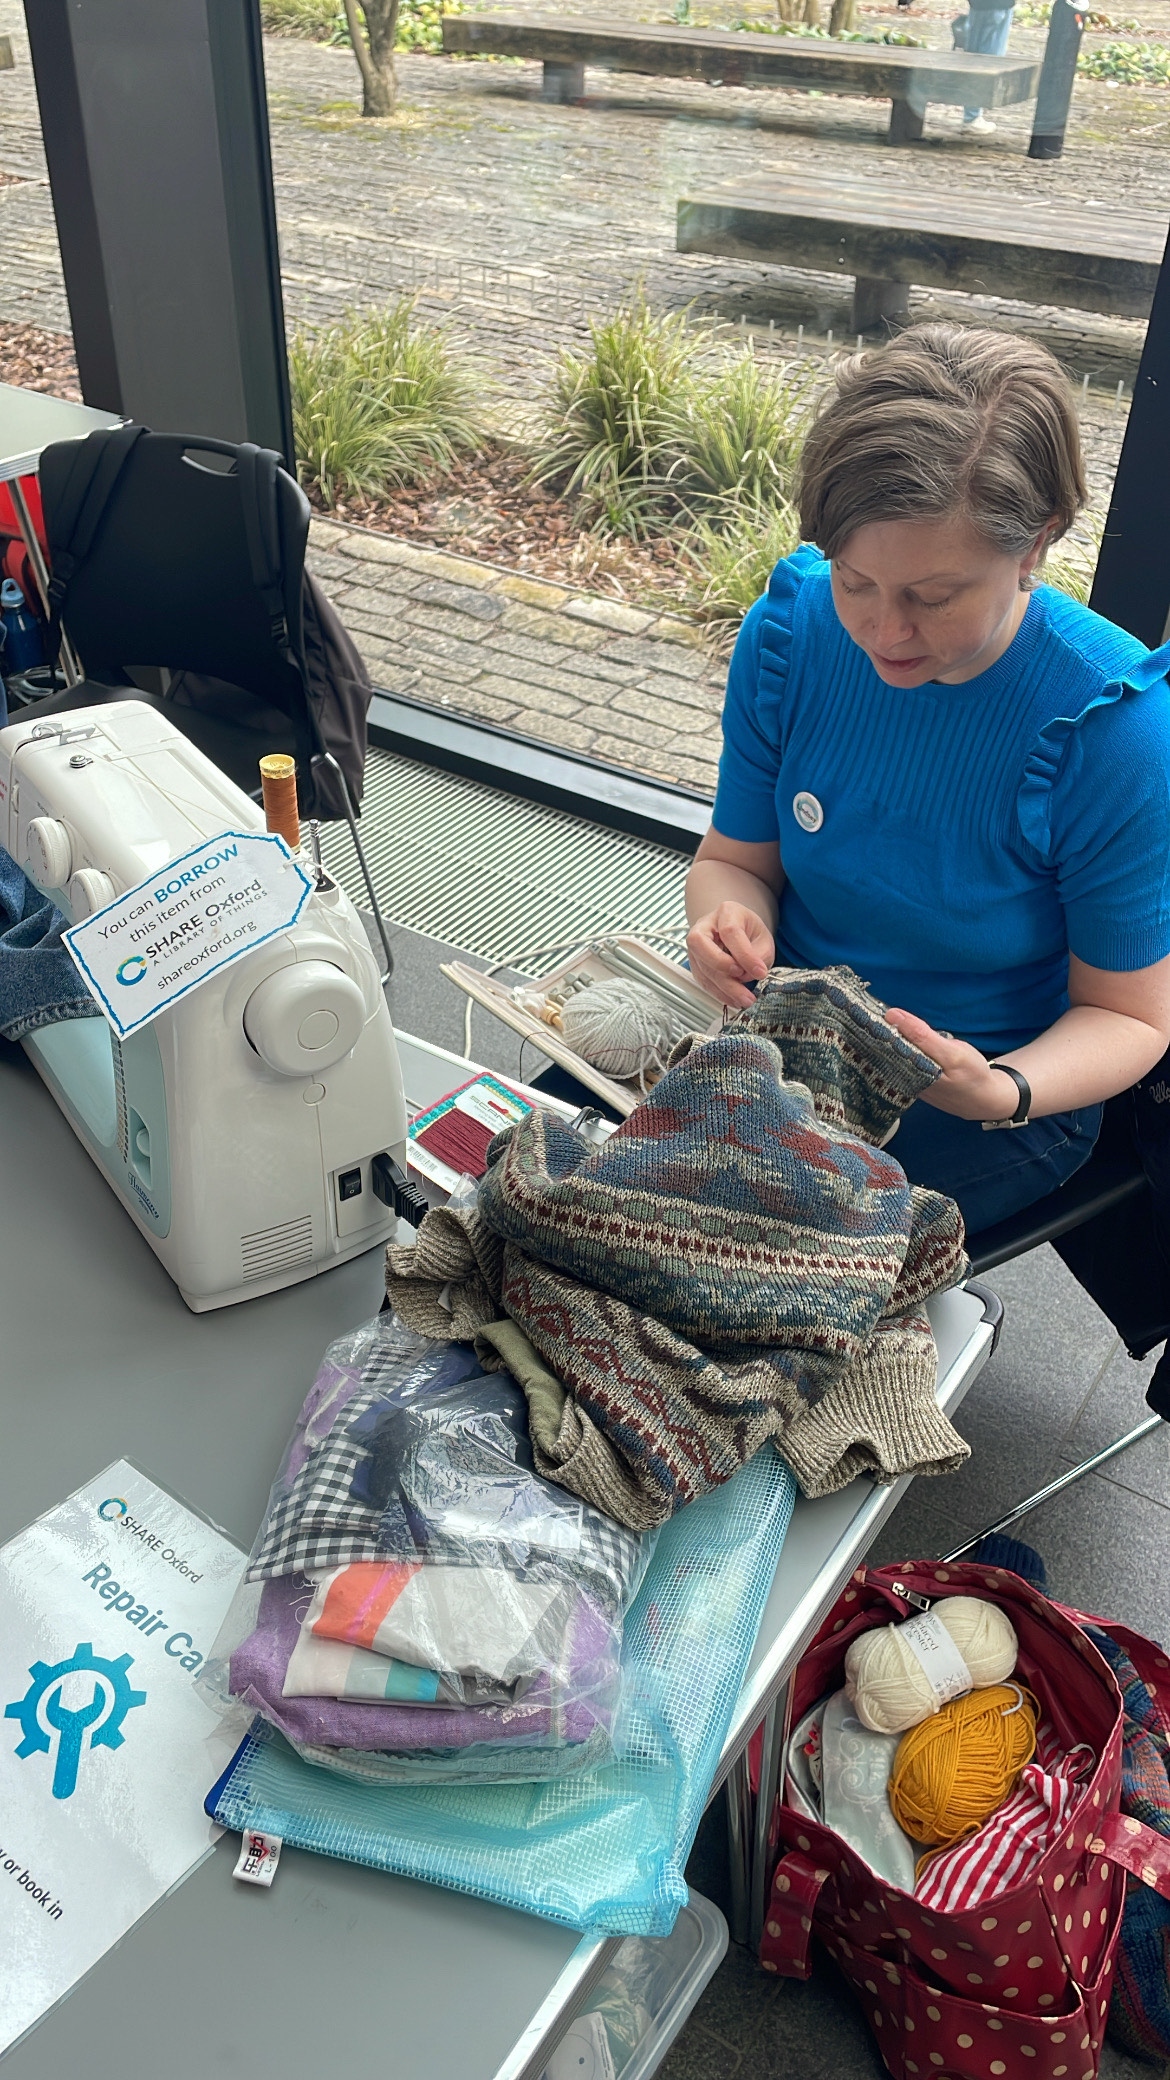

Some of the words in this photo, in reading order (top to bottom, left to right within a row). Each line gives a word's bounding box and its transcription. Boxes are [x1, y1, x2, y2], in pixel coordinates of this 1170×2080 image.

[98, 917, 128, 940] You
[129, 900, 154, 920] can
[153, 844, 239, 904] BORROW
[130, 920, 157, 943] this
[158, 899, 189, 925] item
[189, 875, 226, 902] from
[145, 915, 203, 959] SHARE
[204, 879, 262, 917] Oxford
[153, 959, 160, 967] A
[163, 928, 205, 959] LIBRARY
[210, 915, 225, 928] OF
[226, 890, 268, 916] THINGS
[157, 920, 258, 990] shareoxford.org
[121, 1515, 164, 1552] SHARE
[161, 1548, 204, 1584] Oxford
[81, 1562, 169, 1637] Repair
[4, 1859, 21, 1875] or
[17, 1869, 51, 1907] book
[47, 1900, 63, 1921] in
